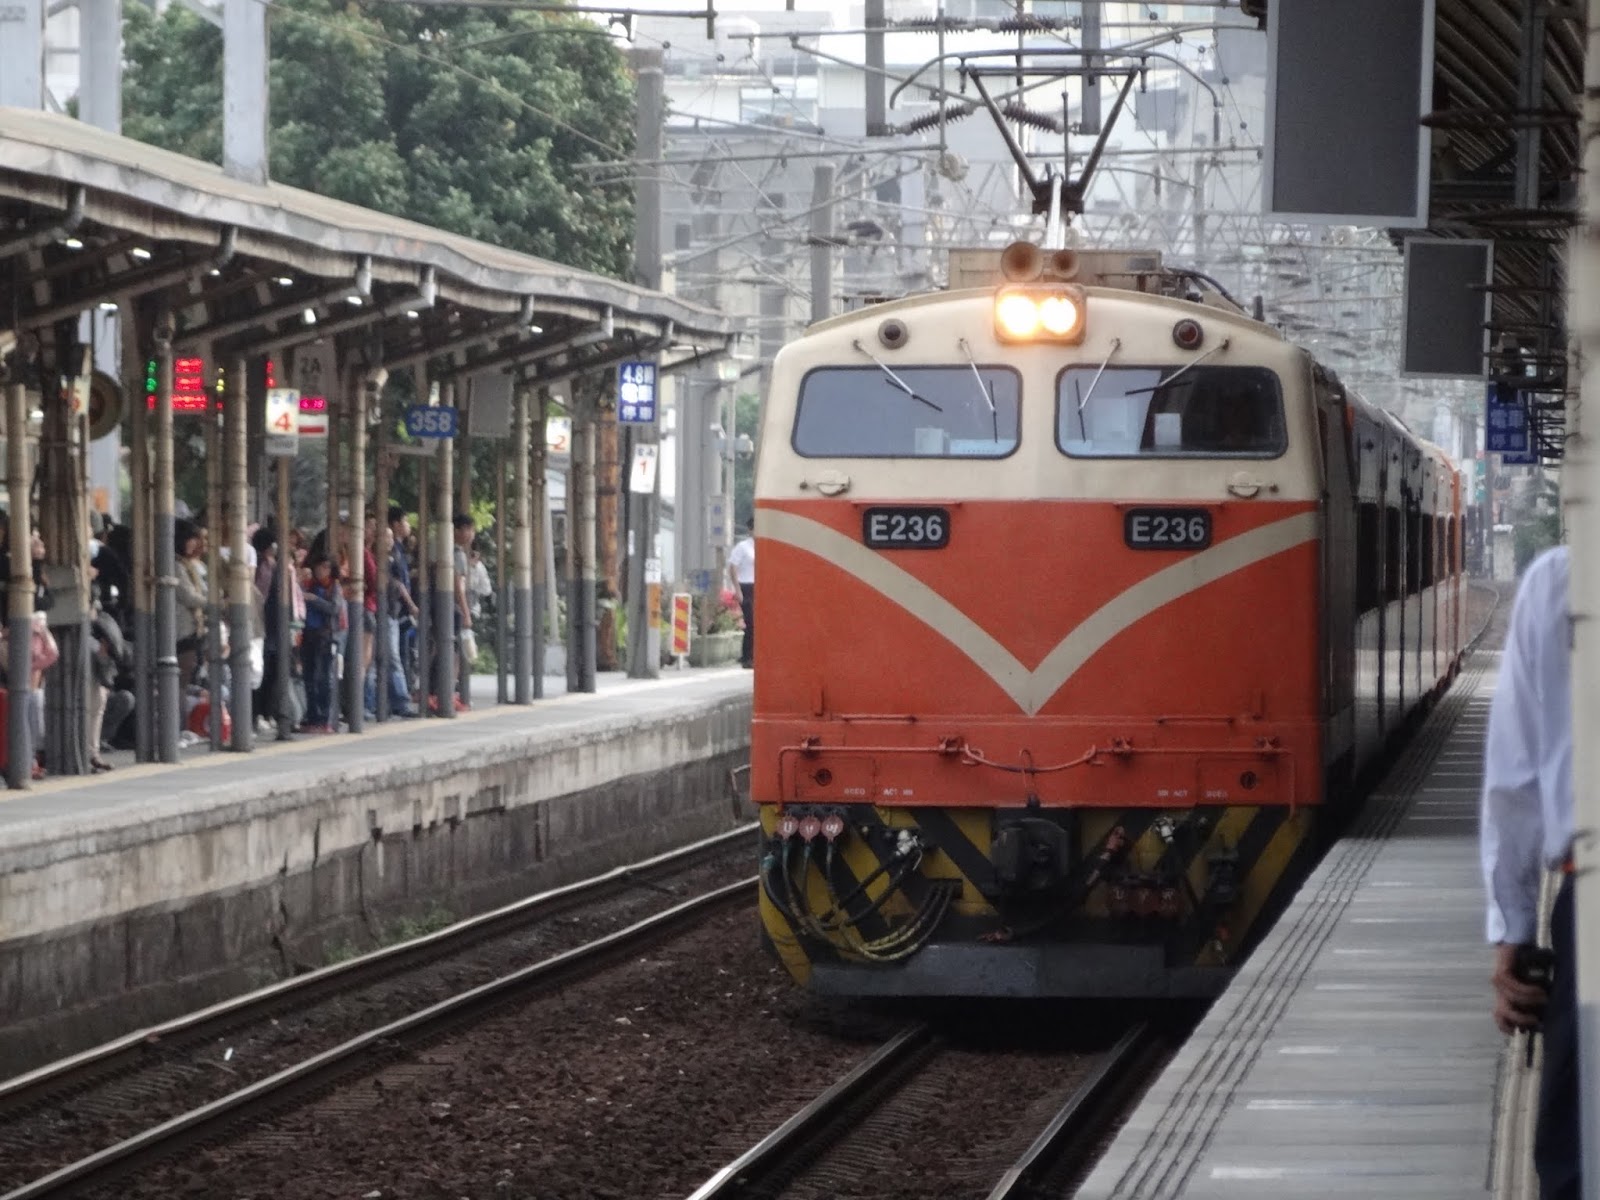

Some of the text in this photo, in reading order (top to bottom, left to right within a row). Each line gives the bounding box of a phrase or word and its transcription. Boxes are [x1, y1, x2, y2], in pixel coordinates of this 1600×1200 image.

[274, 412, 292, 431] 4
[411, 410, 452, 433] 358
[553, 434, 567, 451] 2
[639, 460, 648, 477] 1
[870, 514, 943, 542] E236
[1132, 515, 1205, 543] E236
